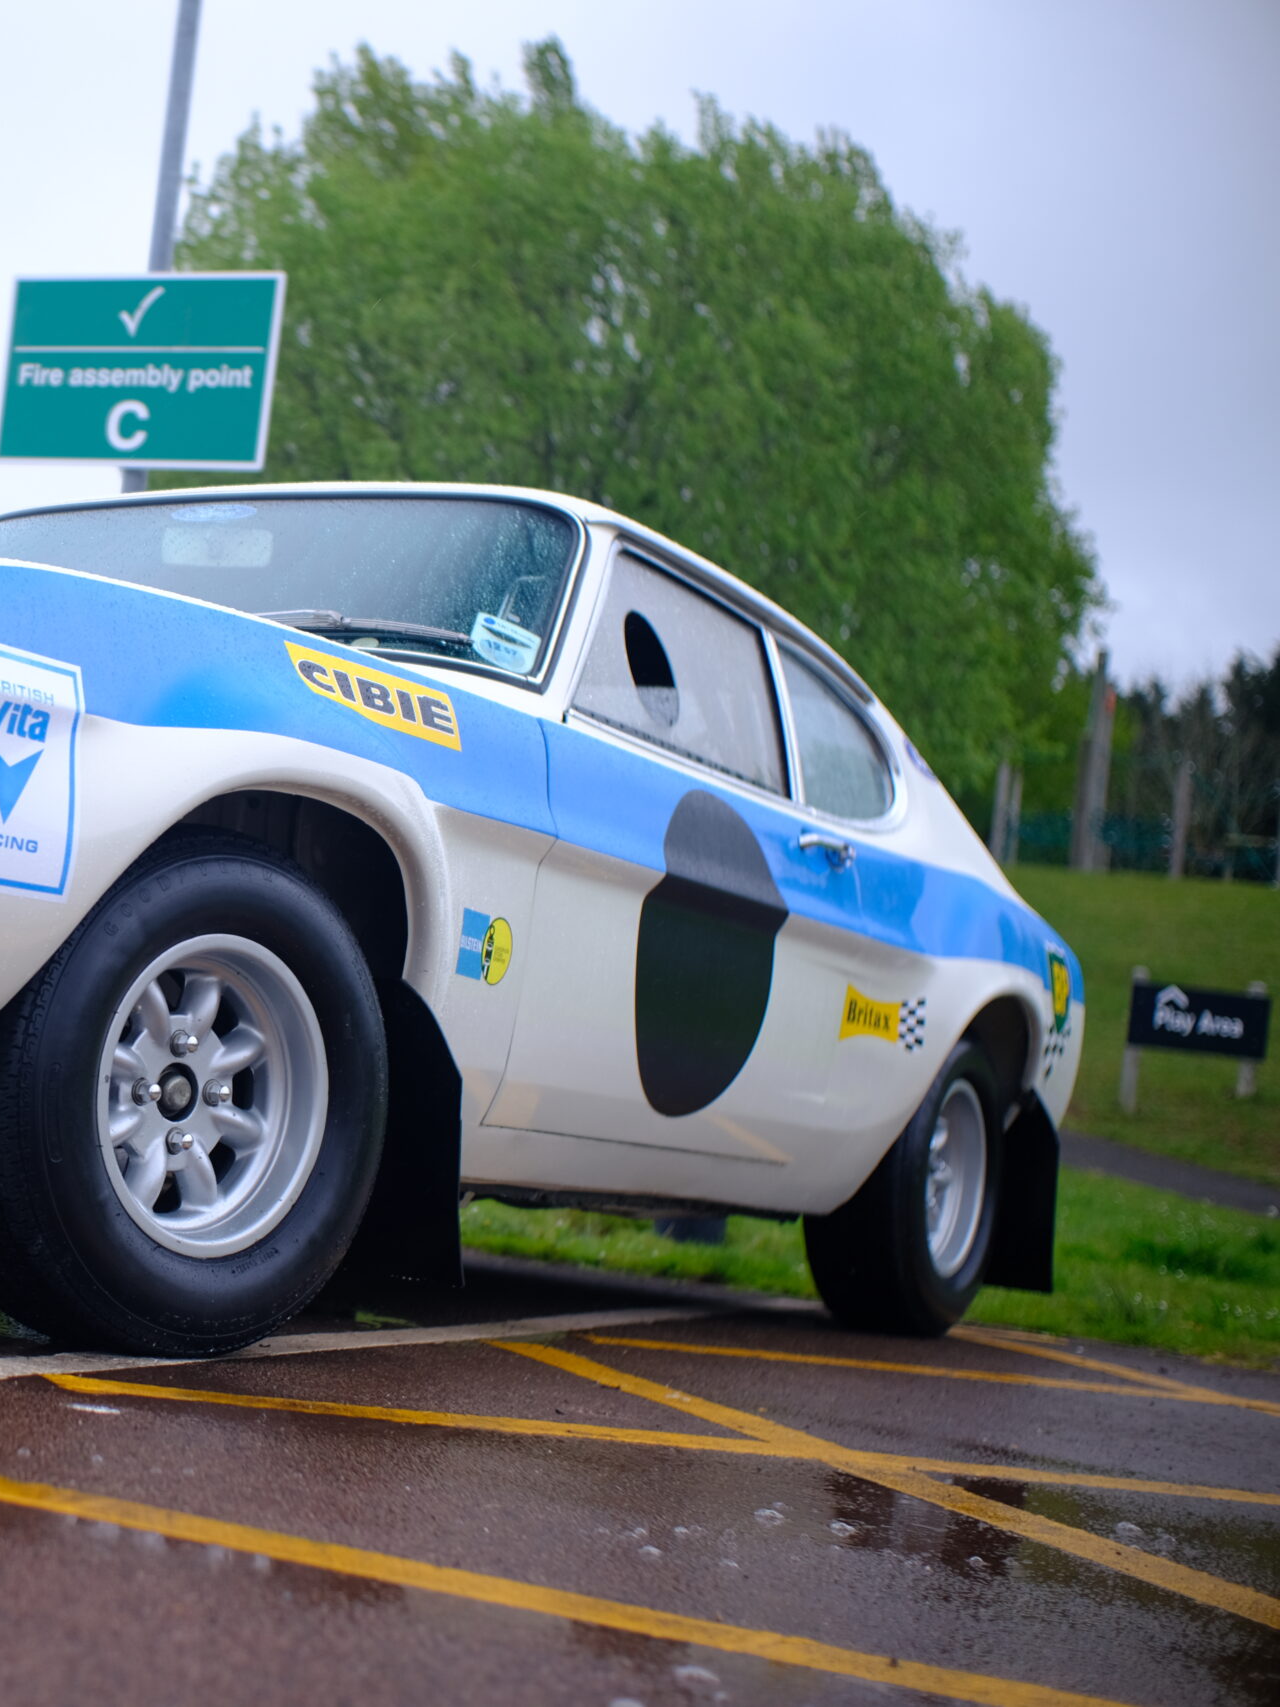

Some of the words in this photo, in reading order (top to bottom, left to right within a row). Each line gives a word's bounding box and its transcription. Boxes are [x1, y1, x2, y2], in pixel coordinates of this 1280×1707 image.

[18, 363, 64, 387] Fire
[68, 363, 183, 393] assembly
[186, 364, 253, 393] point
[105, 399, 151, 452] C
[846, 998, 892, 1032] Britax
[1152, 1002, 1197, 1038] Play
[1195, 1008, 1245, 1040] Area
